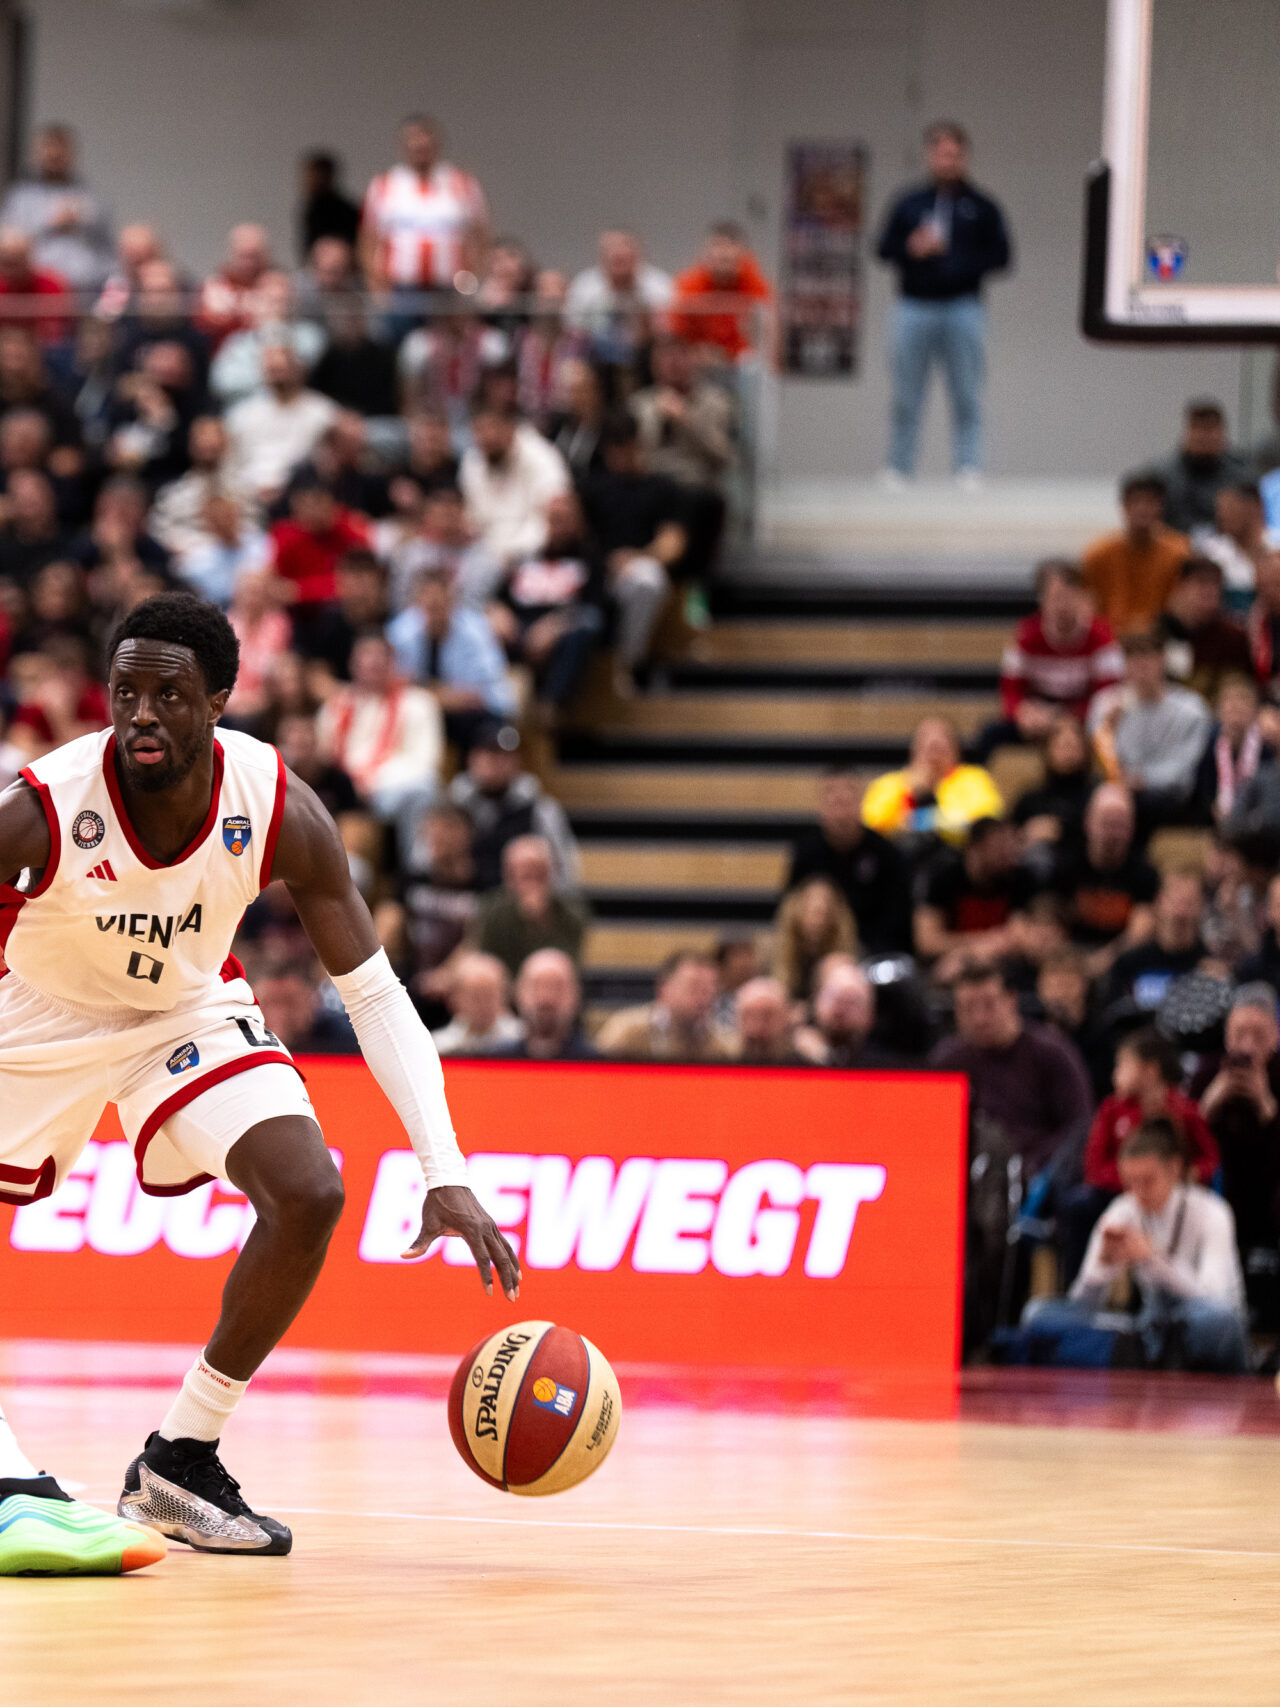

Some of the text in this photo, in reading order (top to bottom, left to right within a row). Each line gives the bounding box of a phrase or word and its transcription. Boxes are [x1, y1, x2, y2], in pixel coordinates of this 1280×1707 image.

[95, 903, 202, 949] VIENA
[357, 1148, 887, 1279] BEWEGT
[475, 1332, 531, 1442] SPALDING
[554, 1388, 576, 1416] ABA
[586, 1389, 612, 1451] LEGACY
